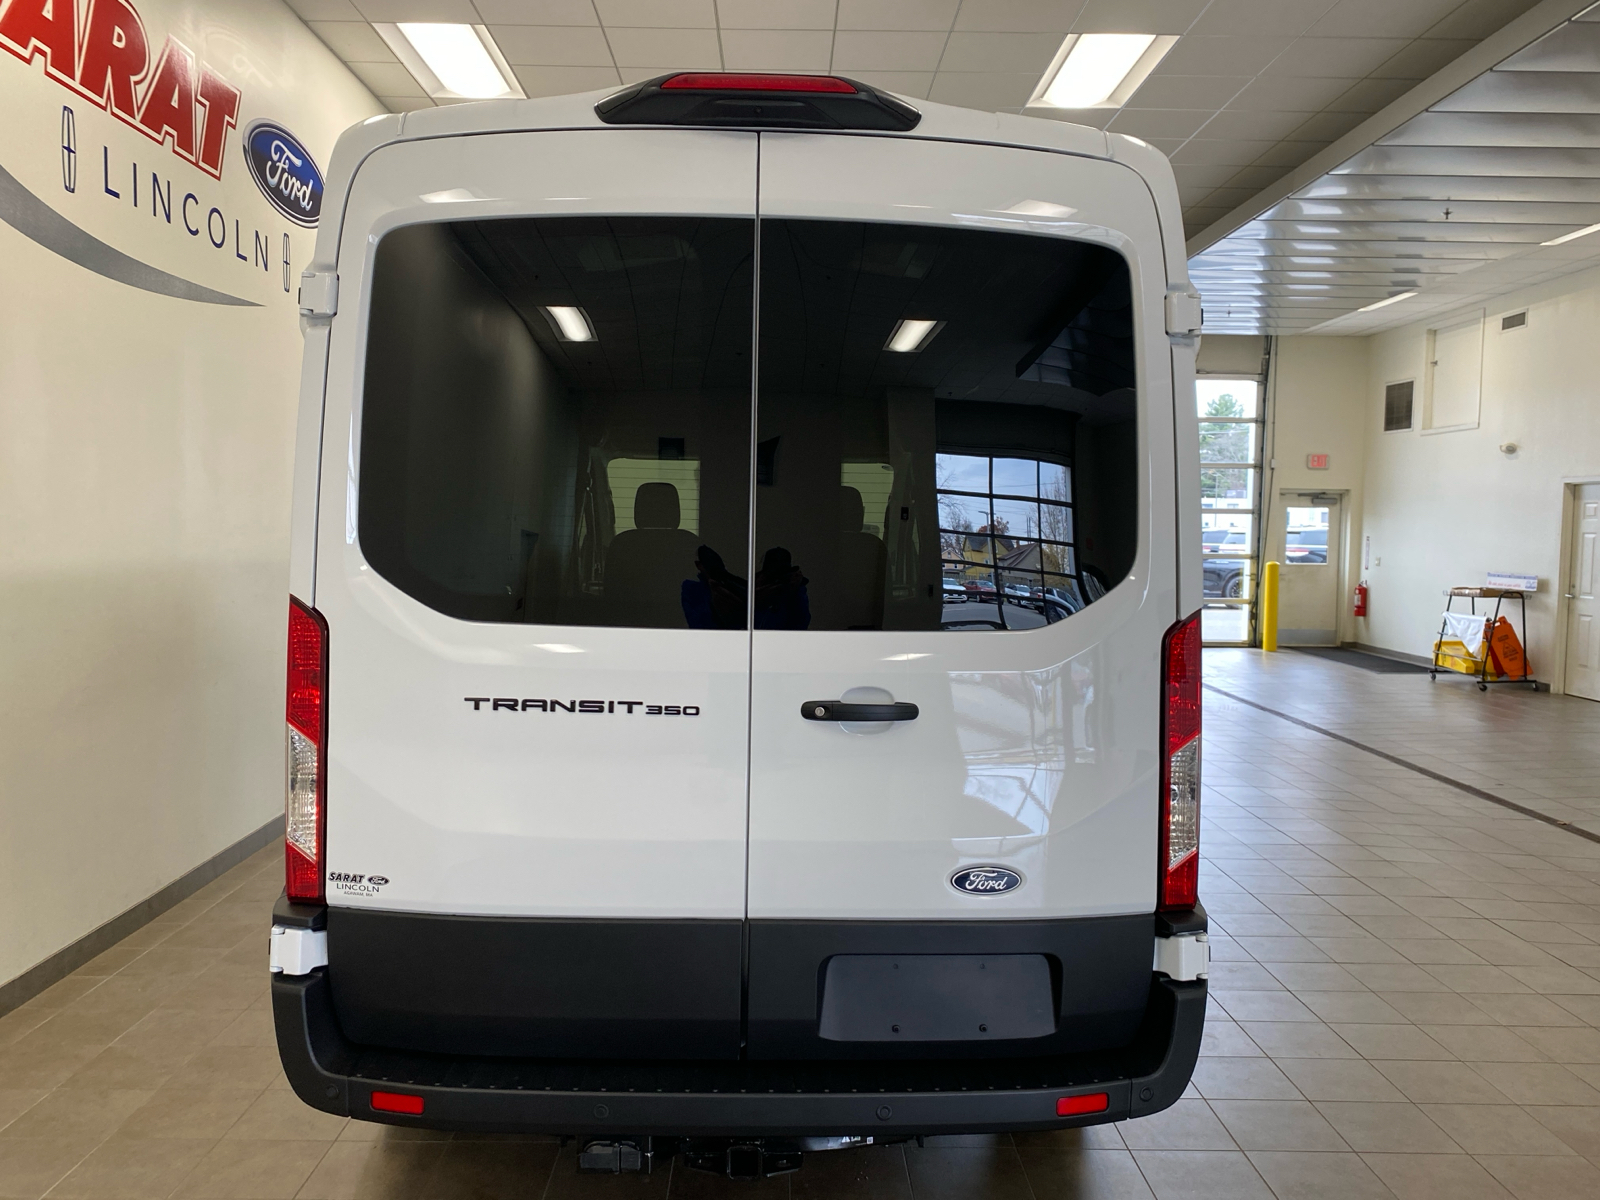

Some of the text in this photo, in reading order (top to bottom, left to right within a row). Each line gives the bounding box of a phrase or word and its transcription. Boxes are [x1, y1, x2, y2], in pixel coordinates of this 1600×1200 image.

[266, 139, 313, 212] Ford
[103, 145, 269, 272] LINCOLN
[328, 872, 365, 884] SARAT
[336, 883, 380, 892] LINCOLN
[965, 871, 1008, 890] Ford
